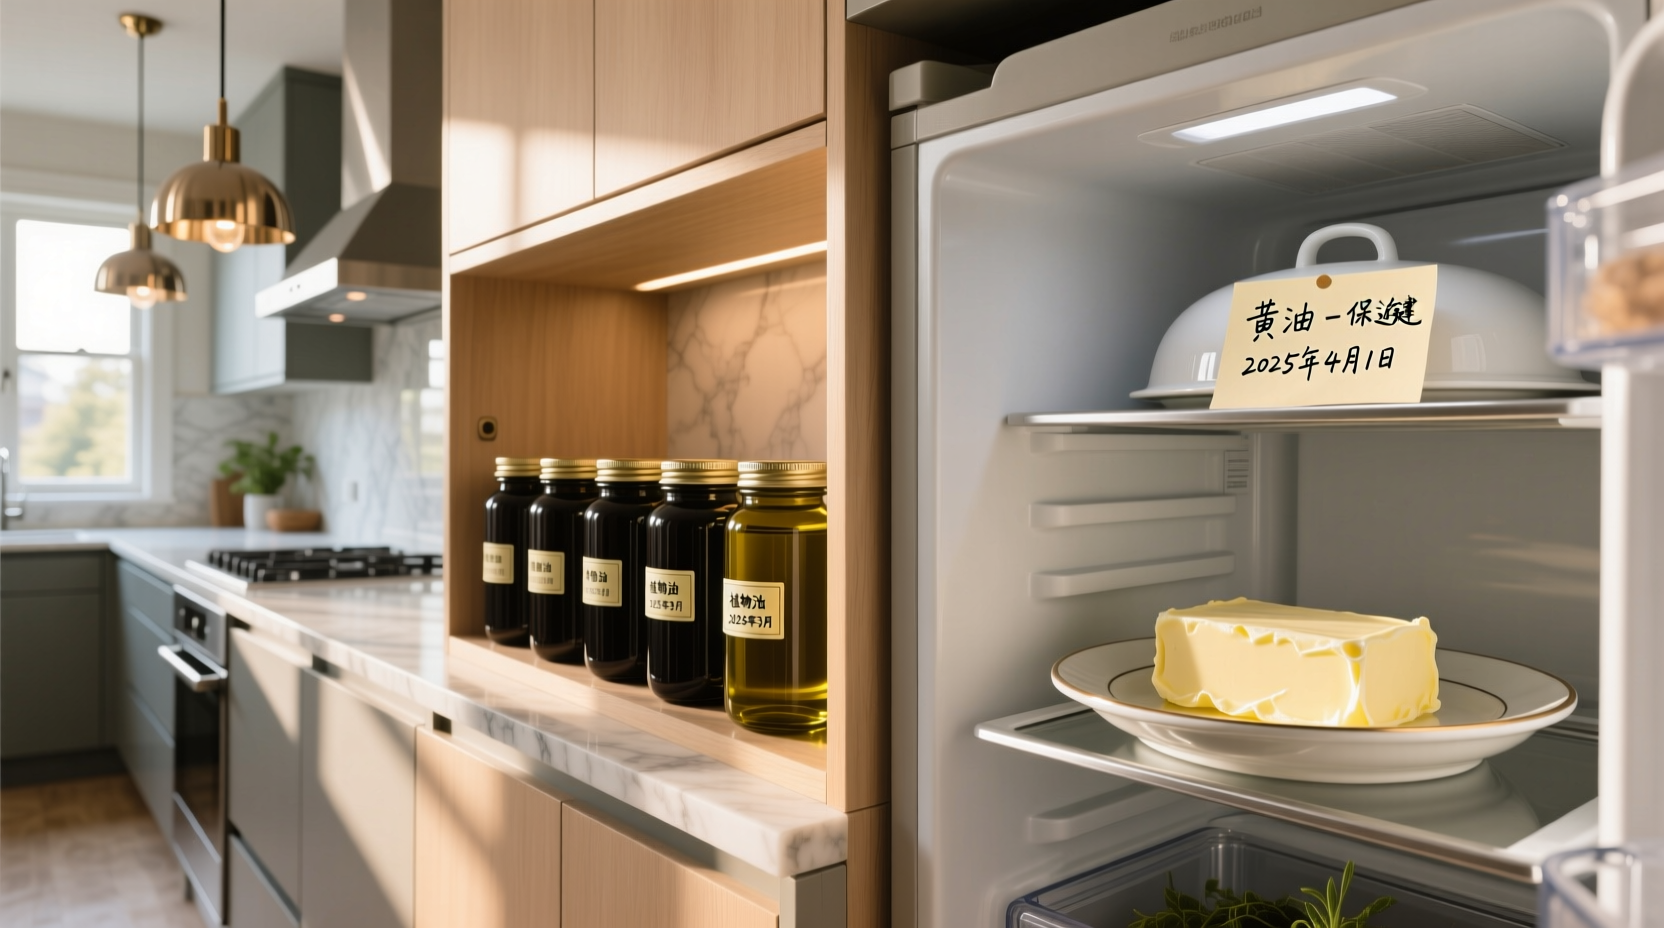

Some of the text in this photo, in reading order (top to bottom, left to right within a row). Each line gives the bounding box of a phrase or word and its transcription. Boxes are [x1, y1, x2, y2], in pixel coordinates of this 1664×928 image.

[1241, 345, 1395, 381] 2025年4月1日
[730, 591, 766, 610] 植物油
